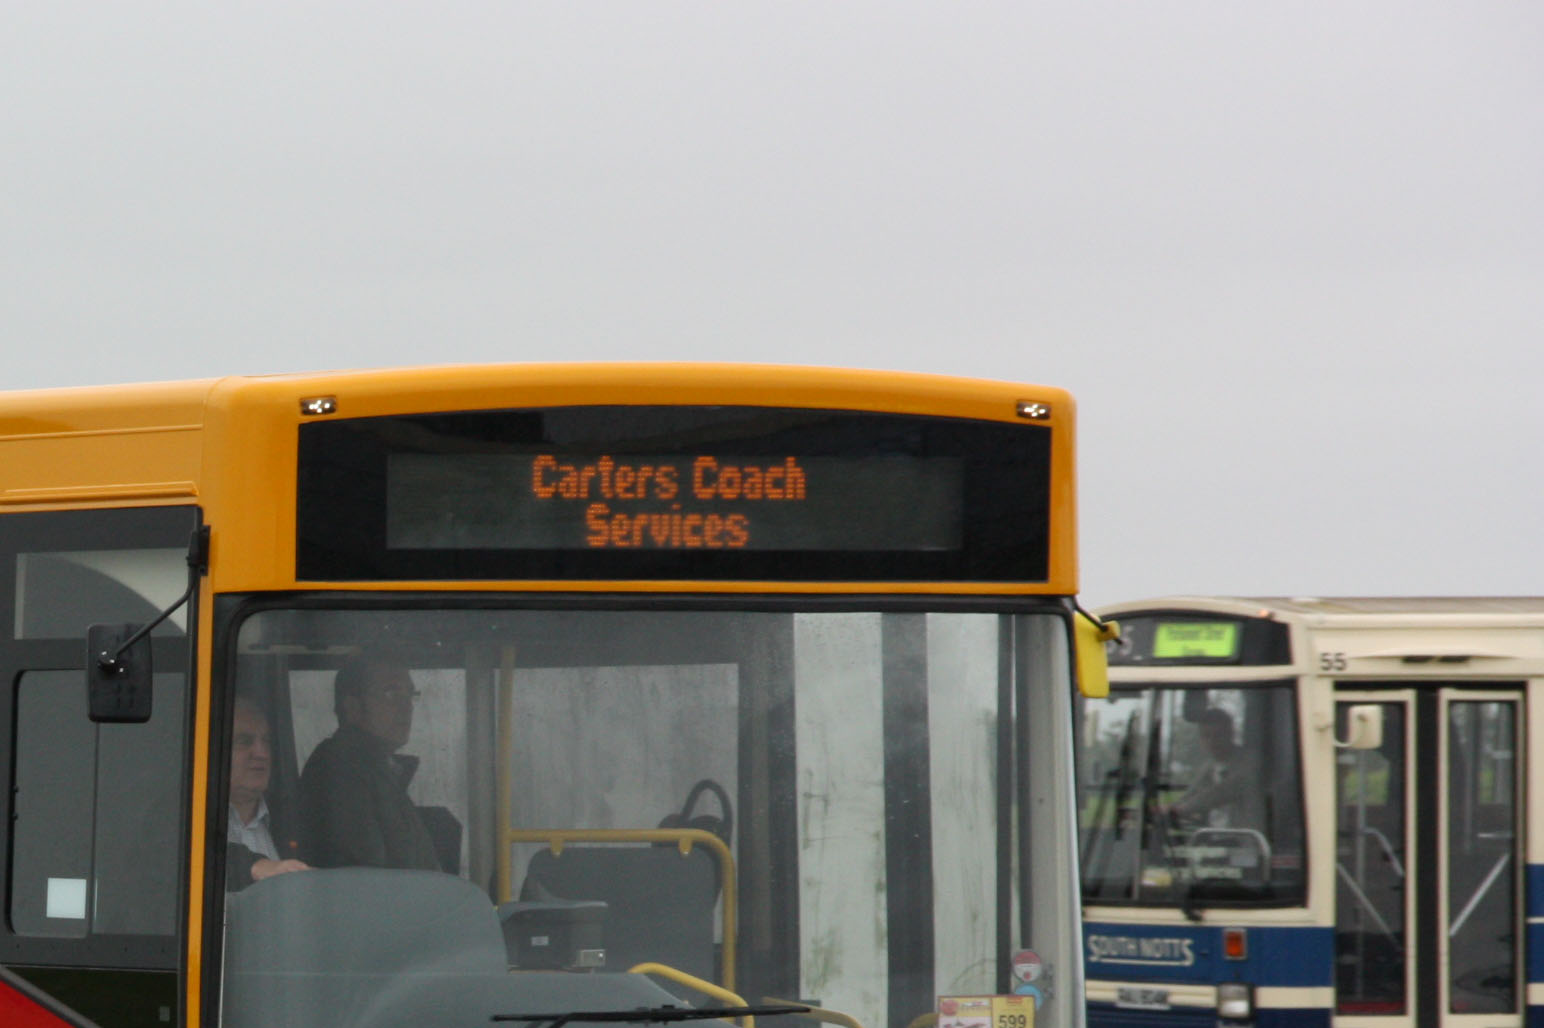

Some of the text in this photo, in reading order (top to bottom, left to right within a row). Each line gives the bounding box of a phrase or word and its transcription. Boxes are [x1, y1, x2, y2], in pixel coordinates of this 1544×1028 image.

[531, 455, 807, 500] Carters Coach
[585, 503, 750, 548] Services
[1319, 651, 1348, 672] 55
[1087, 935, 1195, 967] SOUTH NOTTS
